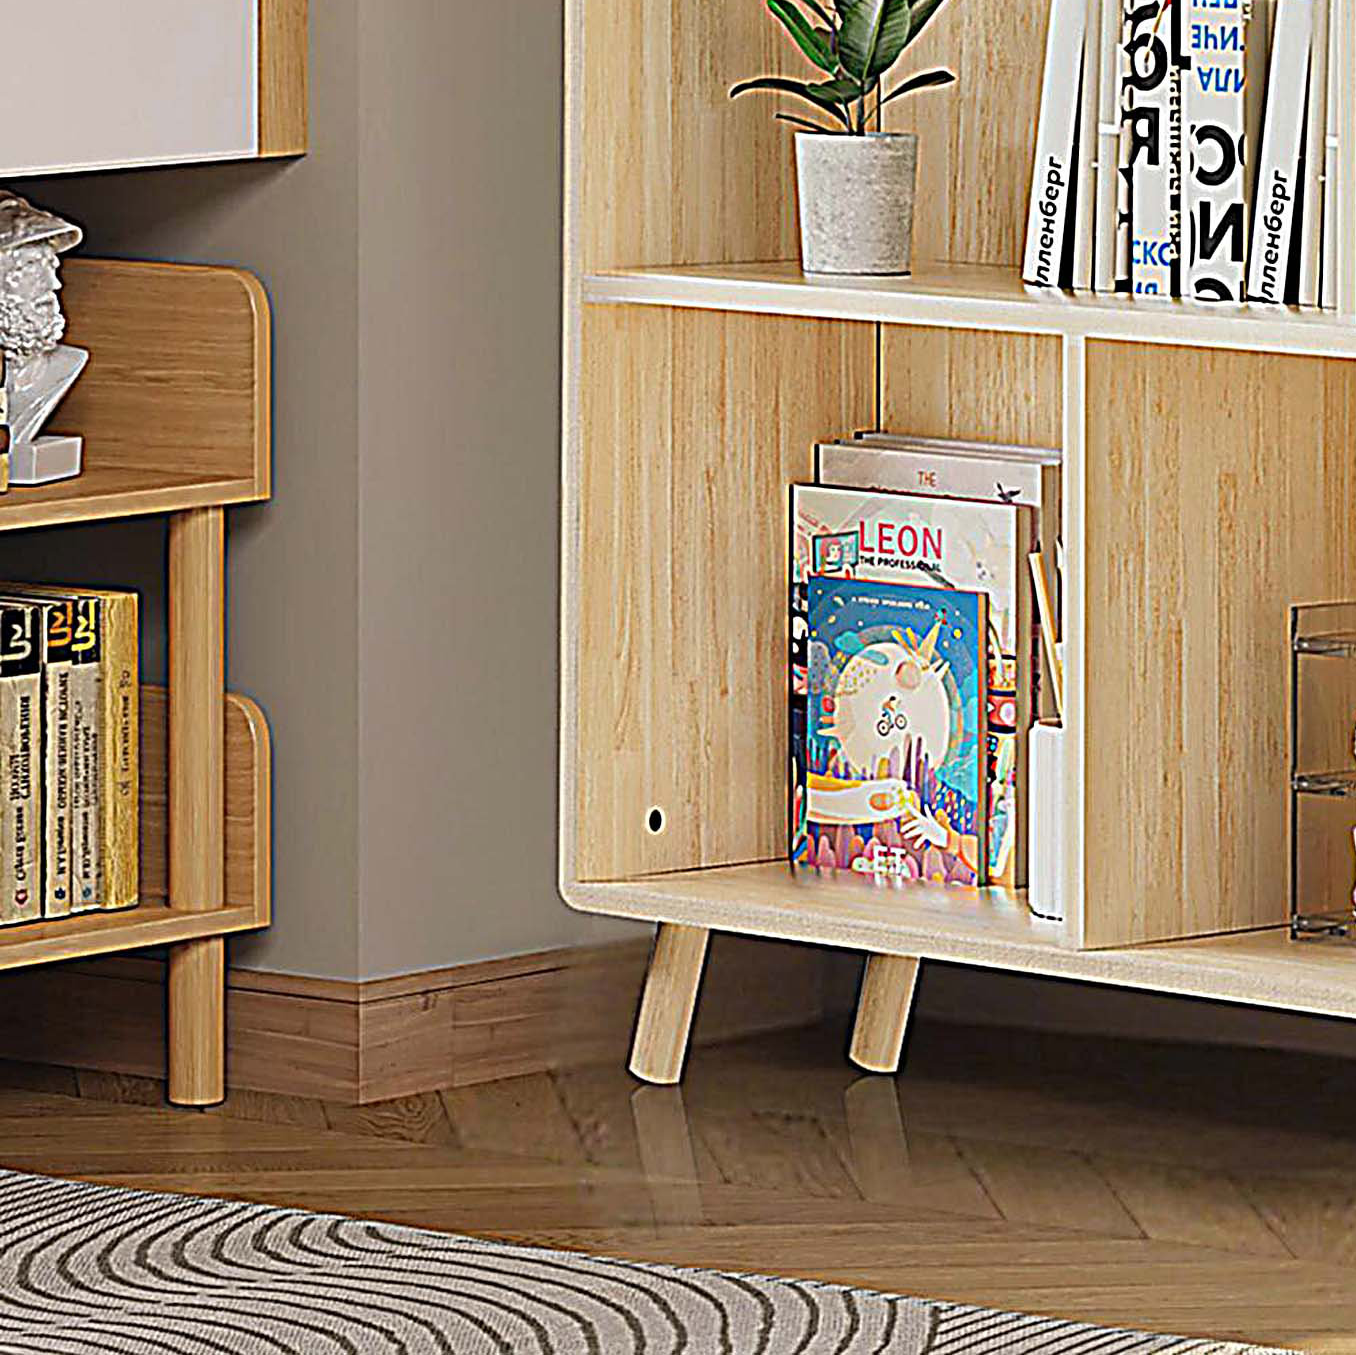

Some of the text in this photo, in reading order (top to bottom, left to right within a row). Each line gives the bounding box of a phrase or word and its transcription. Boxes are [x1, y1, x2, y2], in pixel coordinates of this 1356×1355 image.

[1036, 156, 1065, 286] лленберг
[1261, 170, 1291, 304] лленберг
[917, 470, 937, 488] THE
[859, 520, 943, 559] LEON
[860, 555, 875, 565] THE
